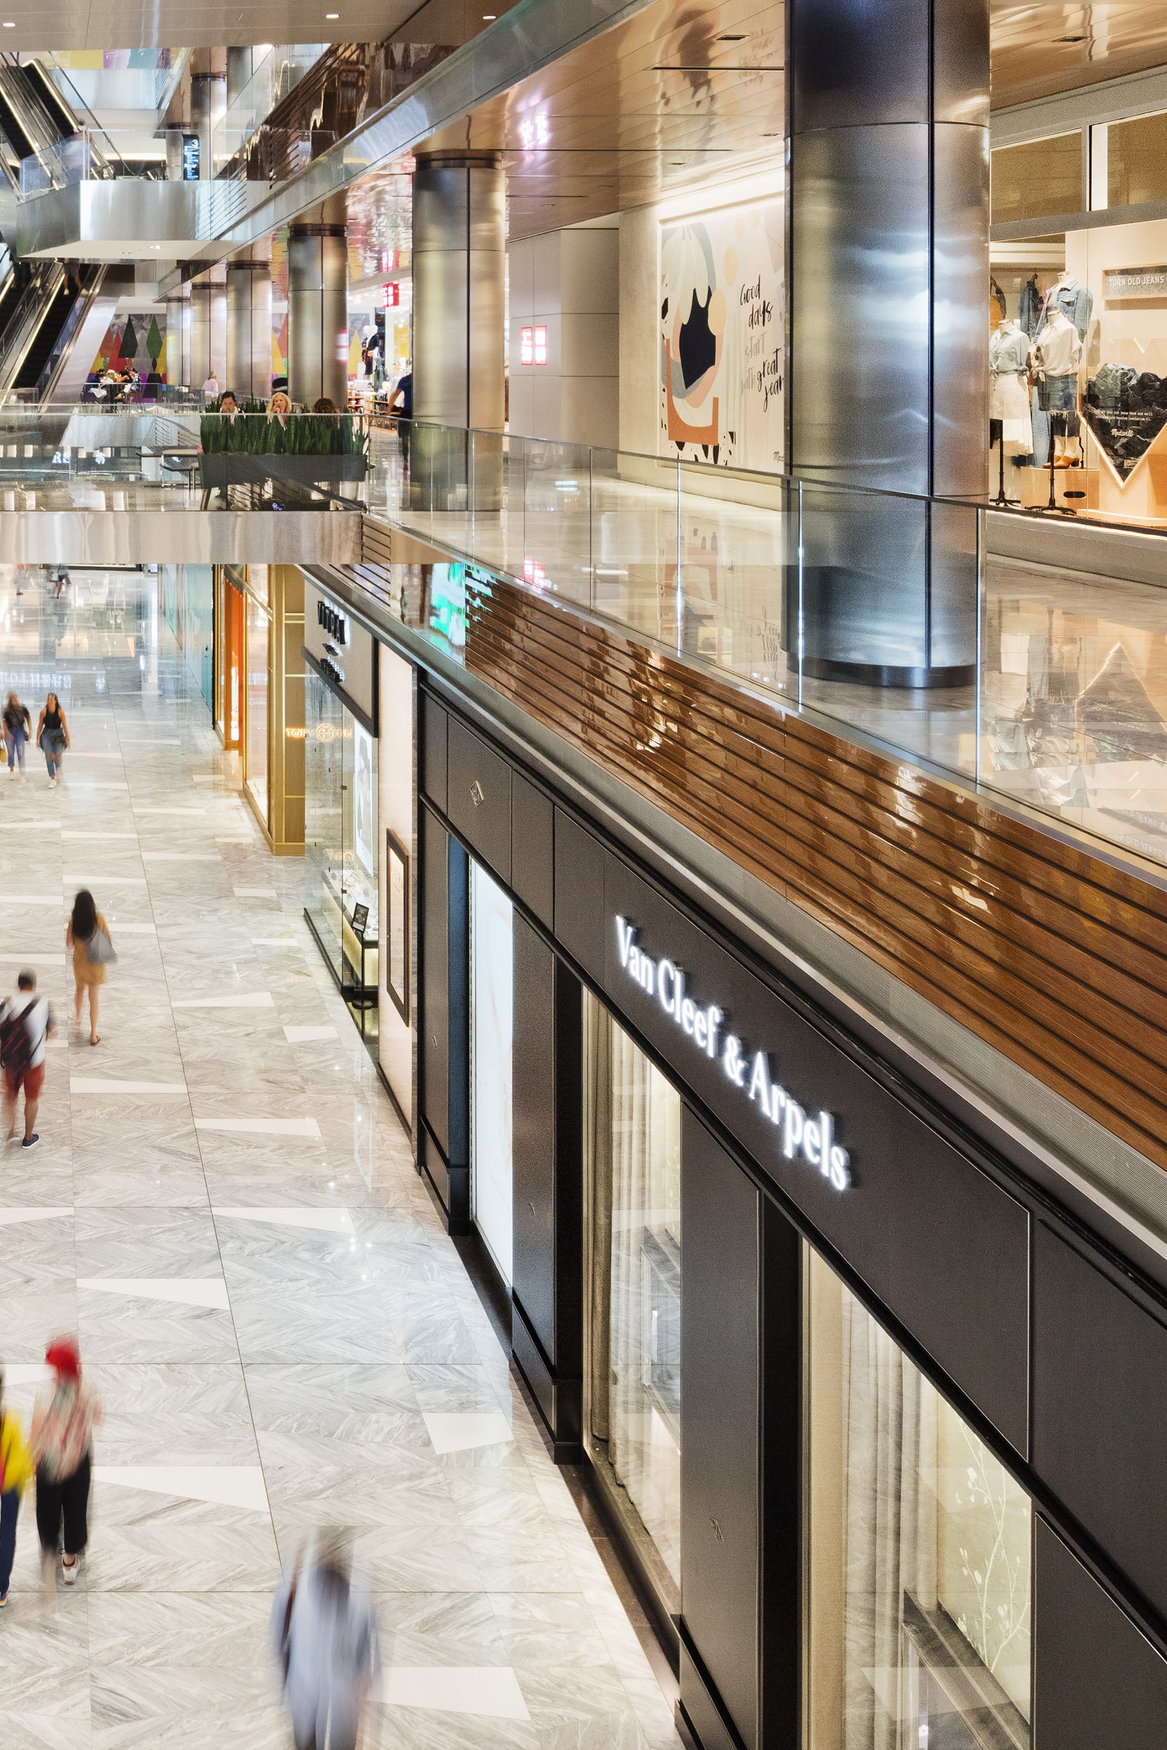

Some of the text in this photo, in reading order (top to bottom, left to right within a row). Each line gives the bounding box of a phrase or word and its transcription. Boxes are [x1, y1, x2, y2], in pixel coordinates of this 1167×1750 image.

[739, 274, 761, 306] Good
[1108, 275, 1164, 287] TURN OLD JEANS
[748, 300, 774, 330] days
[756, 347, 782, 392] great
[615, 914, 852, 1192] Van Cleef & Arpels
